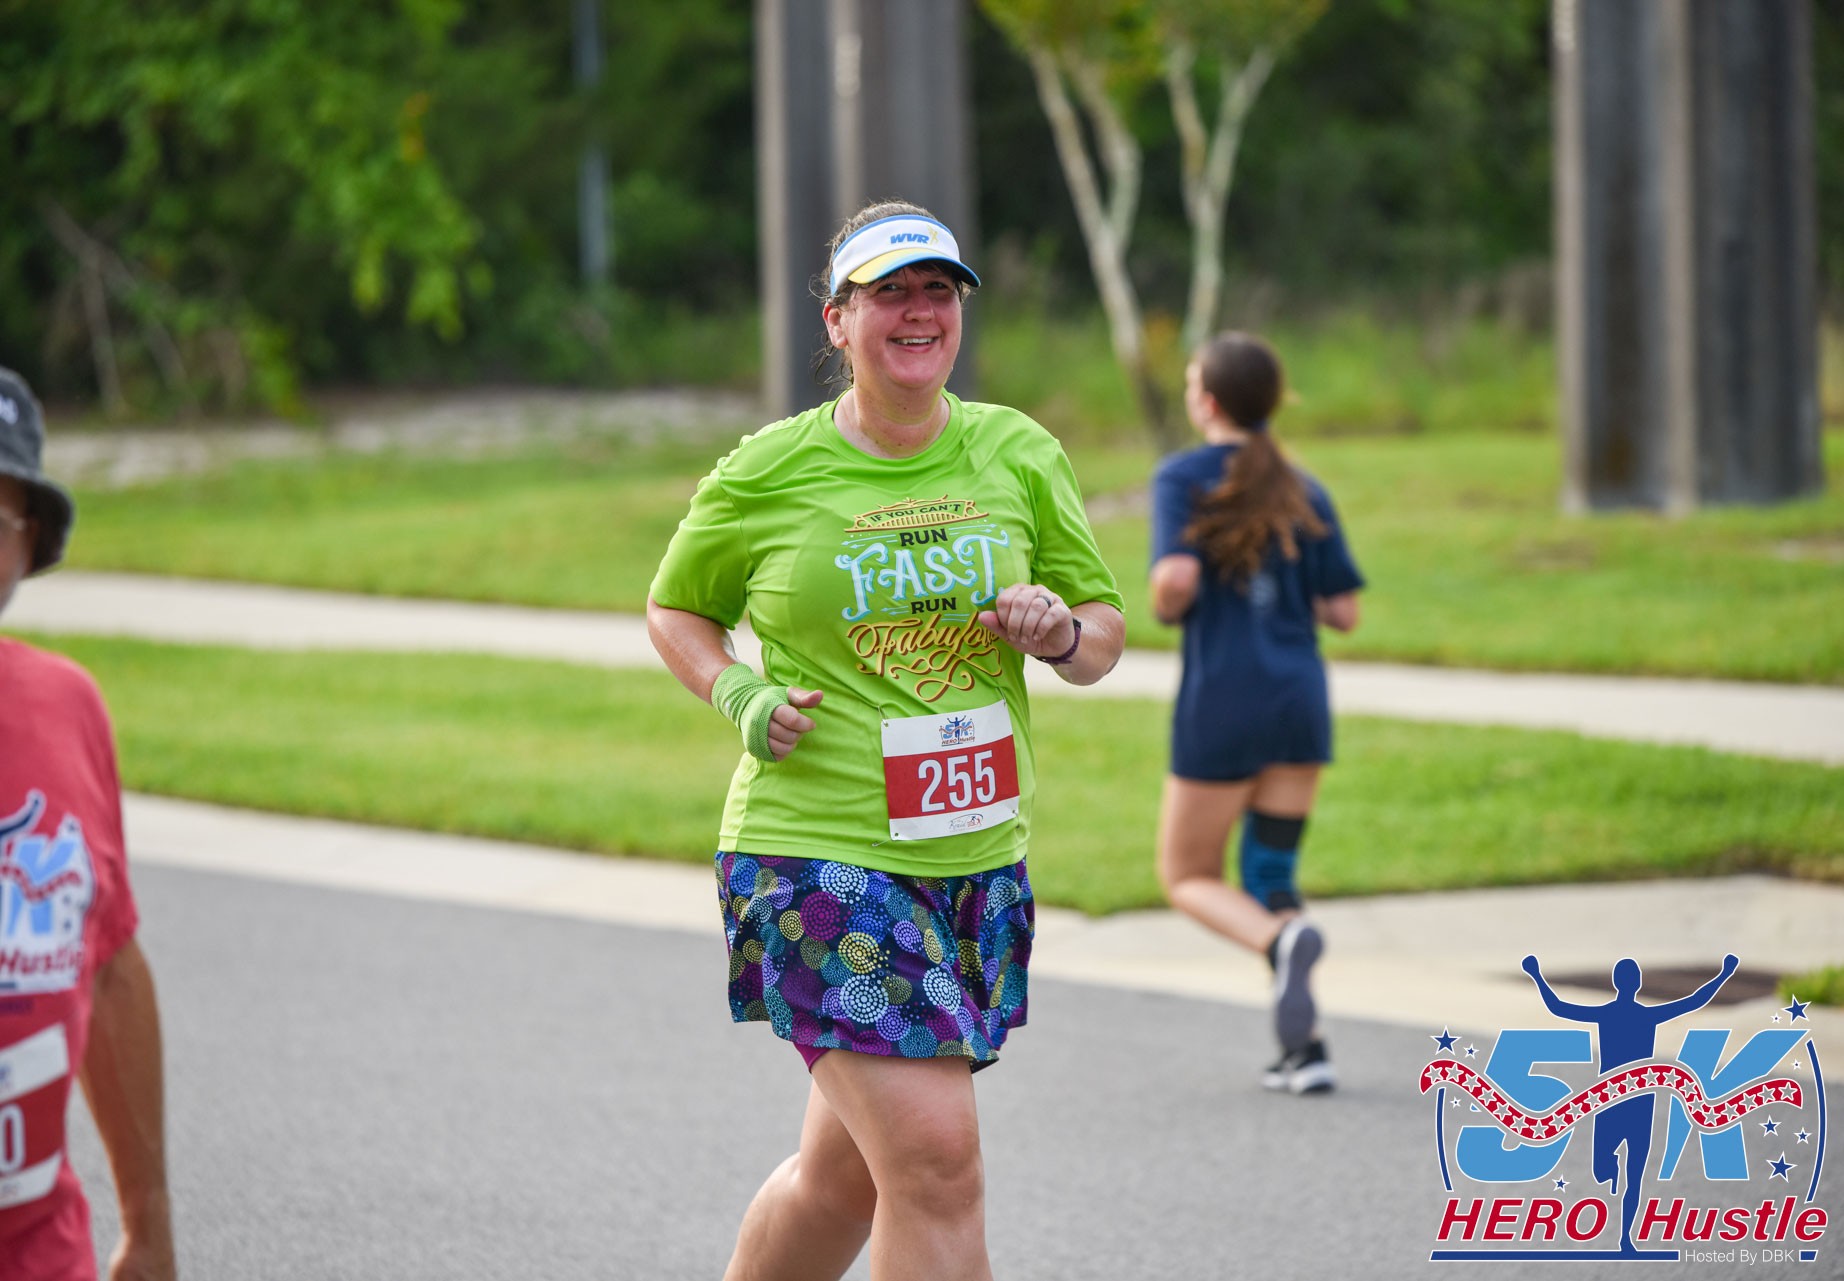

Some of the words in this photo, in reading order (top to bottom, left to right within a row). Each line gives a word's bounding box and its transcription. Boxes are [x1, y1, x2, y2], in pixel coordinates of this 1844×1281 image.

[890, 233, 930, 245] WVR
[870, 514, 883, 523] IF
[886, 509, 915, 519] YOU
[920, 503, 961, 515] CAN'T
[899, 528, 948, 547] RUN
[834, 530, 1009, 621] FAST
[911, 597, 957, 614] RUN
[917, 749, 997, 813] 255
